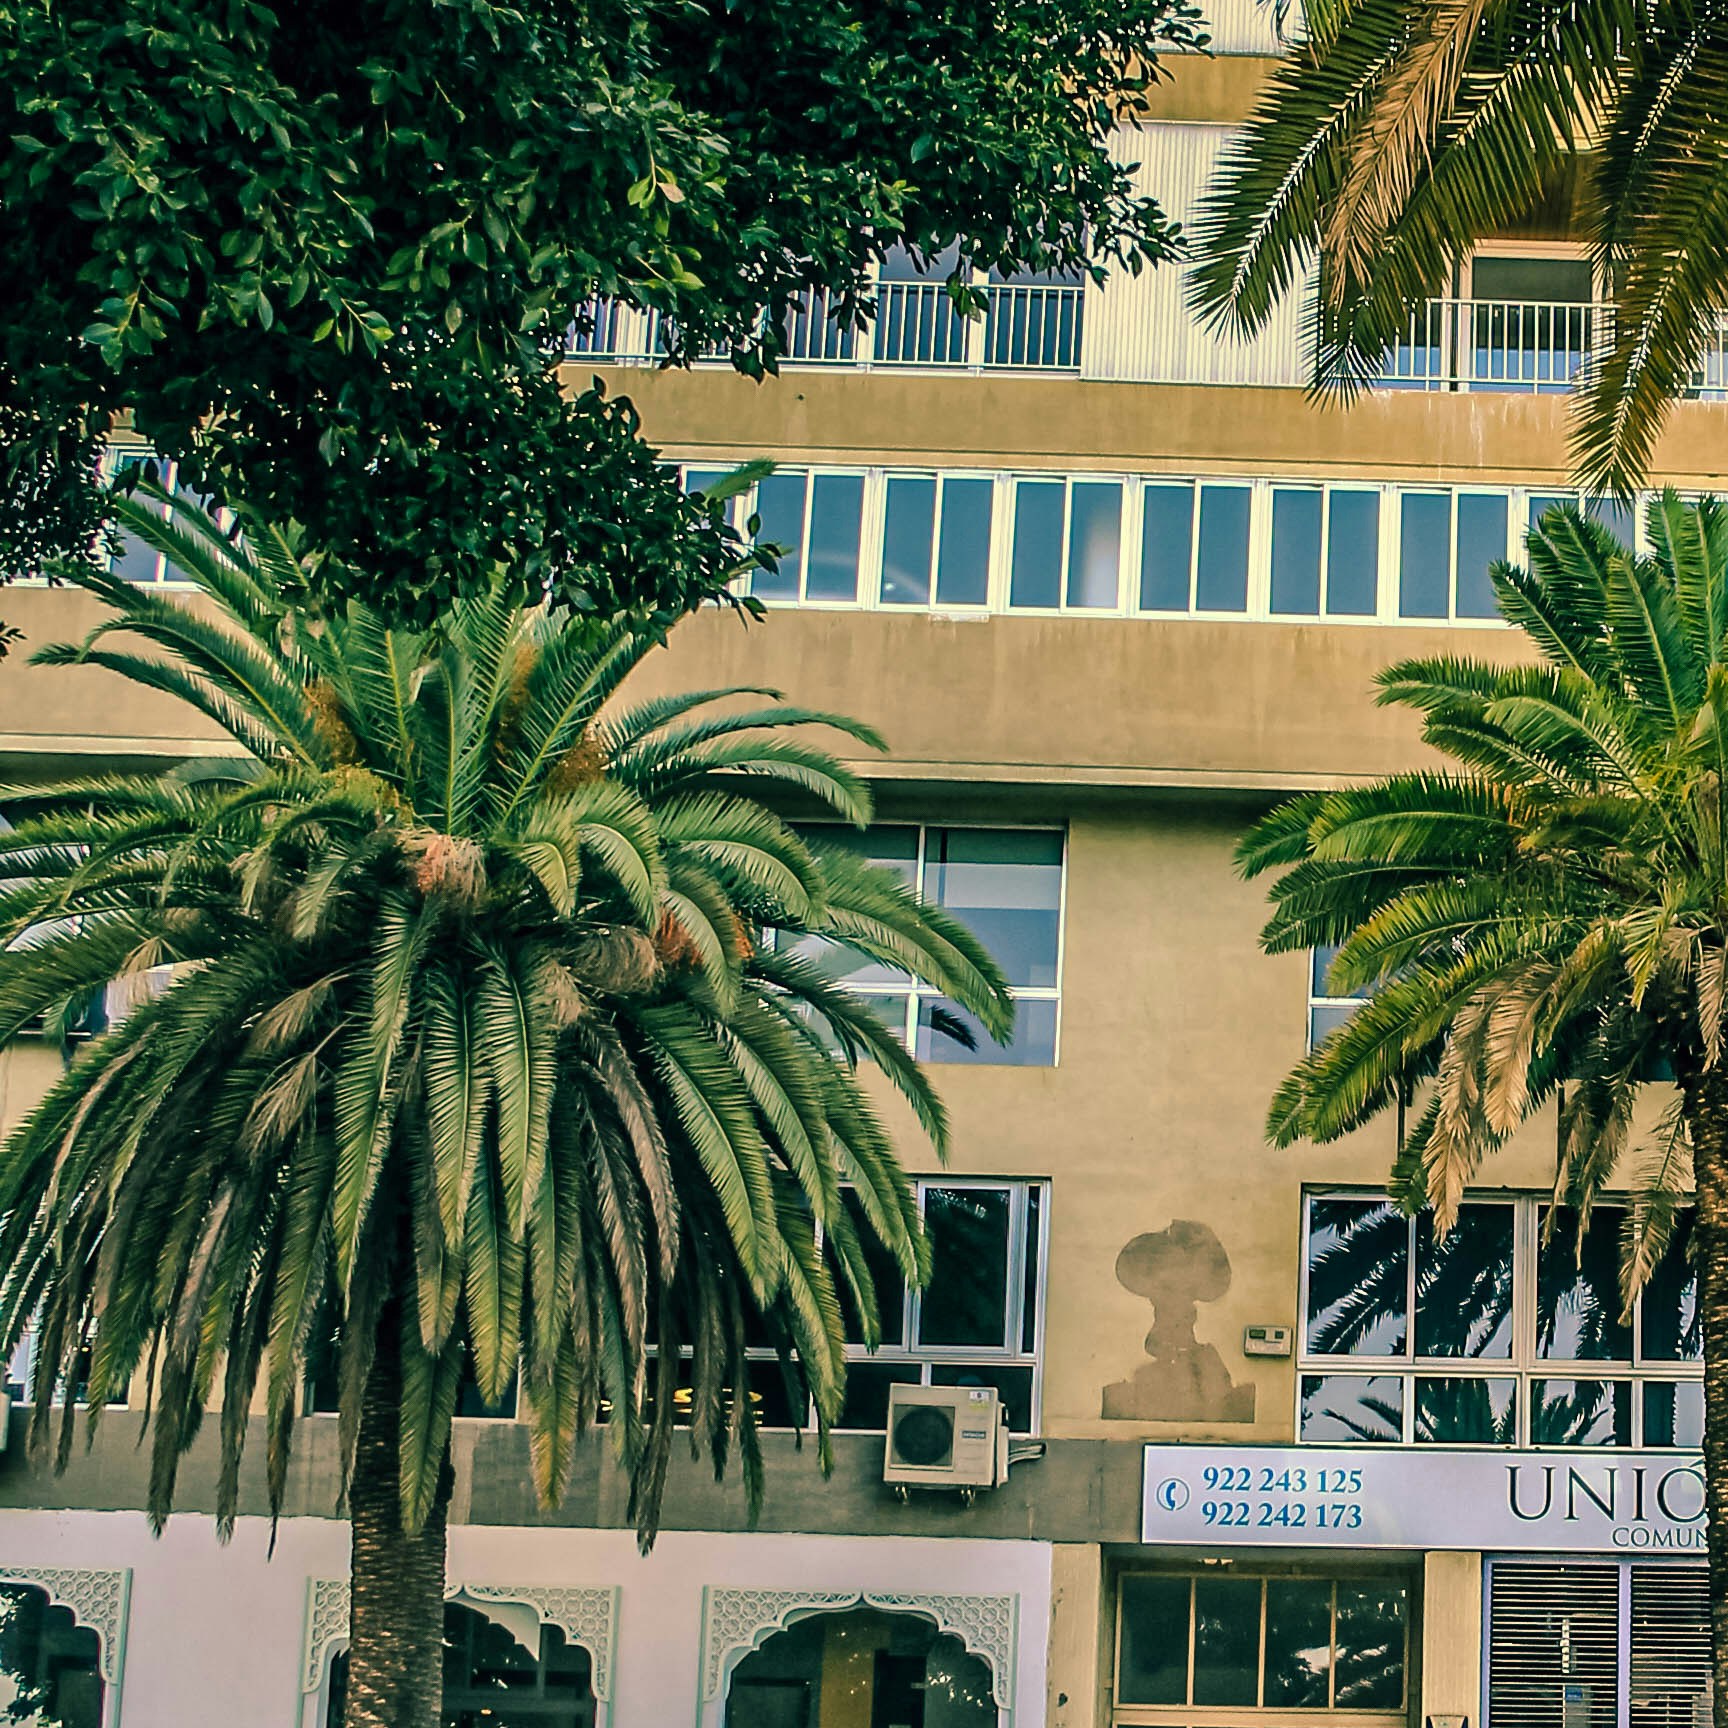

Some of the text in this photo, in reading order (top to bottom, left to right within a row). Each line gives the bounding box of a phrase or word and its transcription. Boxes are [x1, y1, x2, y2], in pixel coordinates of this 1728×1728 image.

[1203, 1466, 1363, 1493] 922 243 125
[1504, 1459, 1707, 1522] UNIÓ
[1201, 1501, 1363, 1528] 922 242 173
[1612, 1527, 1709, 1547] COMUN
